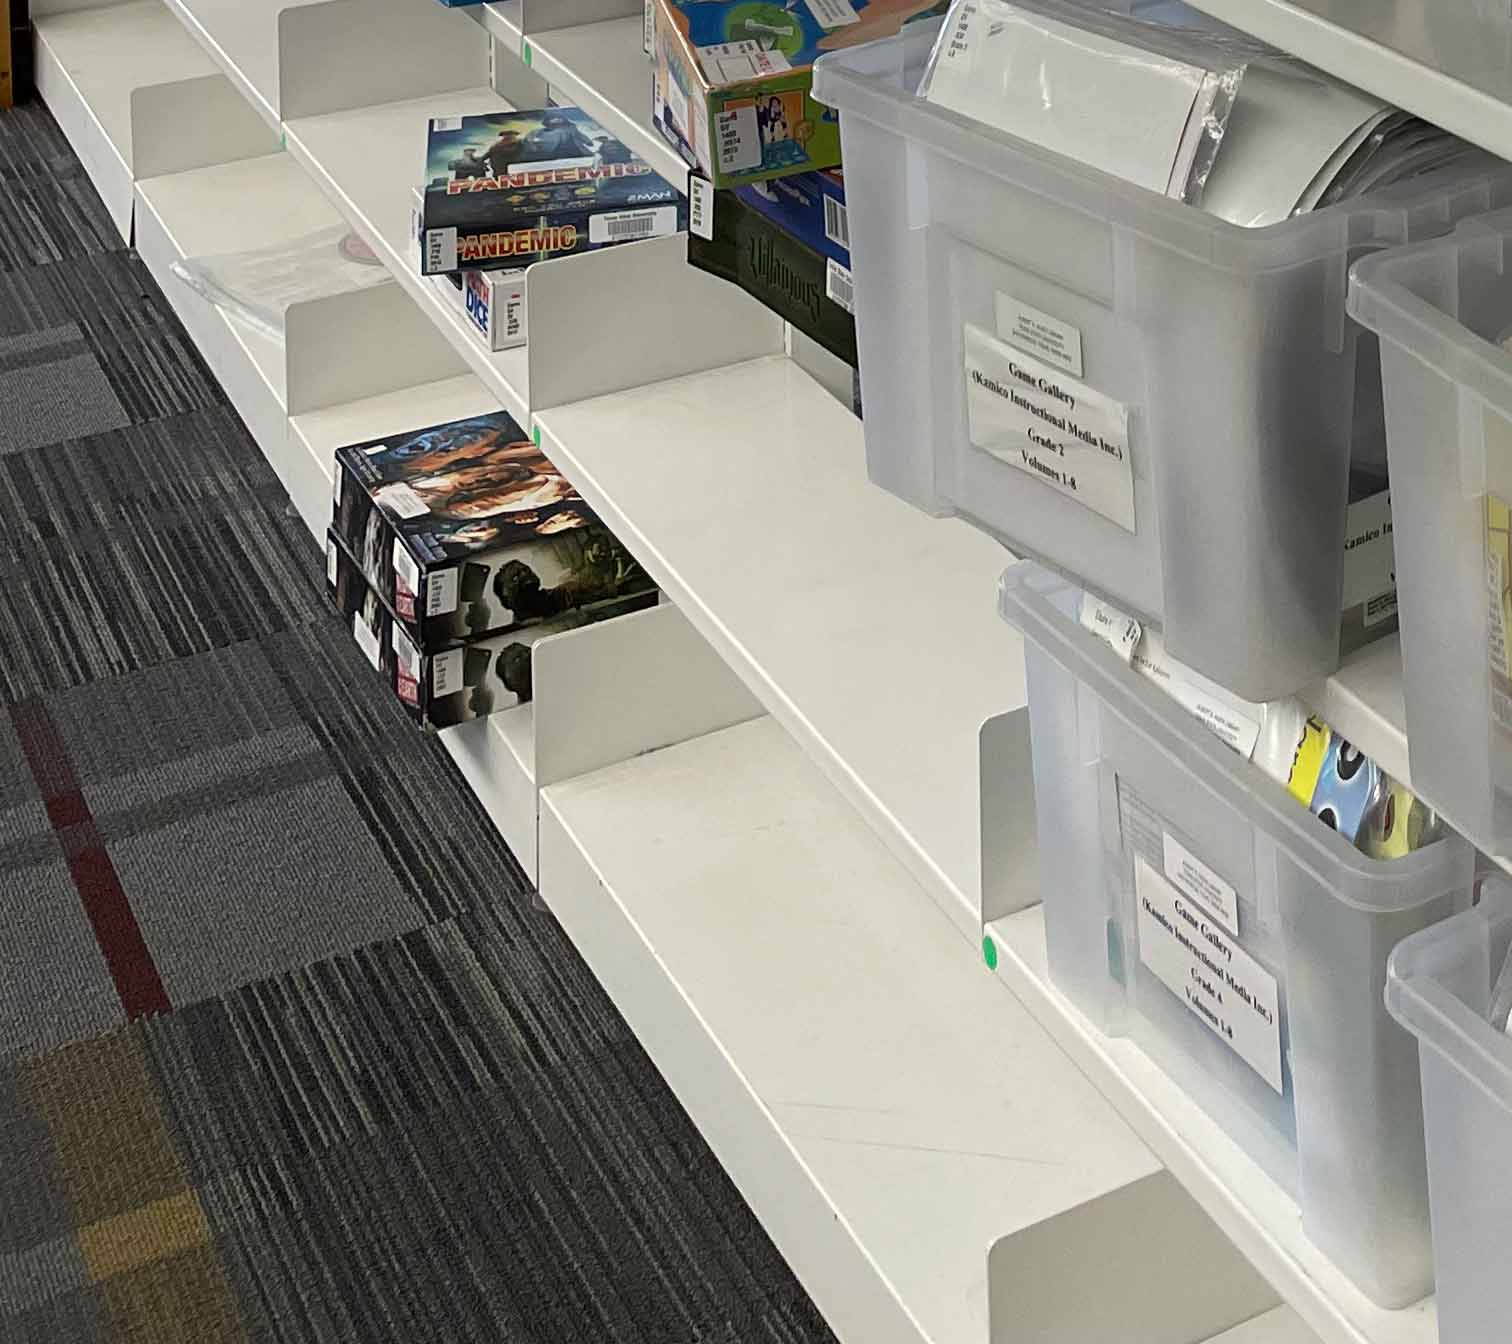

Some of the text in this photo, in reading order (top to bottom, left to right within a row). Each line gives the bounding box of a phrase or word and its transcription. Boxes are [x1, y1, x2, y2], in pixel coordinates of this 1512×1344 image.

[446, 162, 654, 196] PANDEMIC
[1008, 361, 1076, 411] Game Gallery
[972, 369, 1124, 461] (Kamico Instructional Media Inc.)
[1027, 427, 1065, 458] Grade 2
[1021, 449, 1060, 482] Volumes
[1174, 899, 1233, 963] Game Gallery
[1174, 928, 1225, 983] Instructional
[1225, 972, 1252, 1007] Media
[1190, 967, 1216, 999] Grade
[1184, 986, 1219, 1028] Volumes
